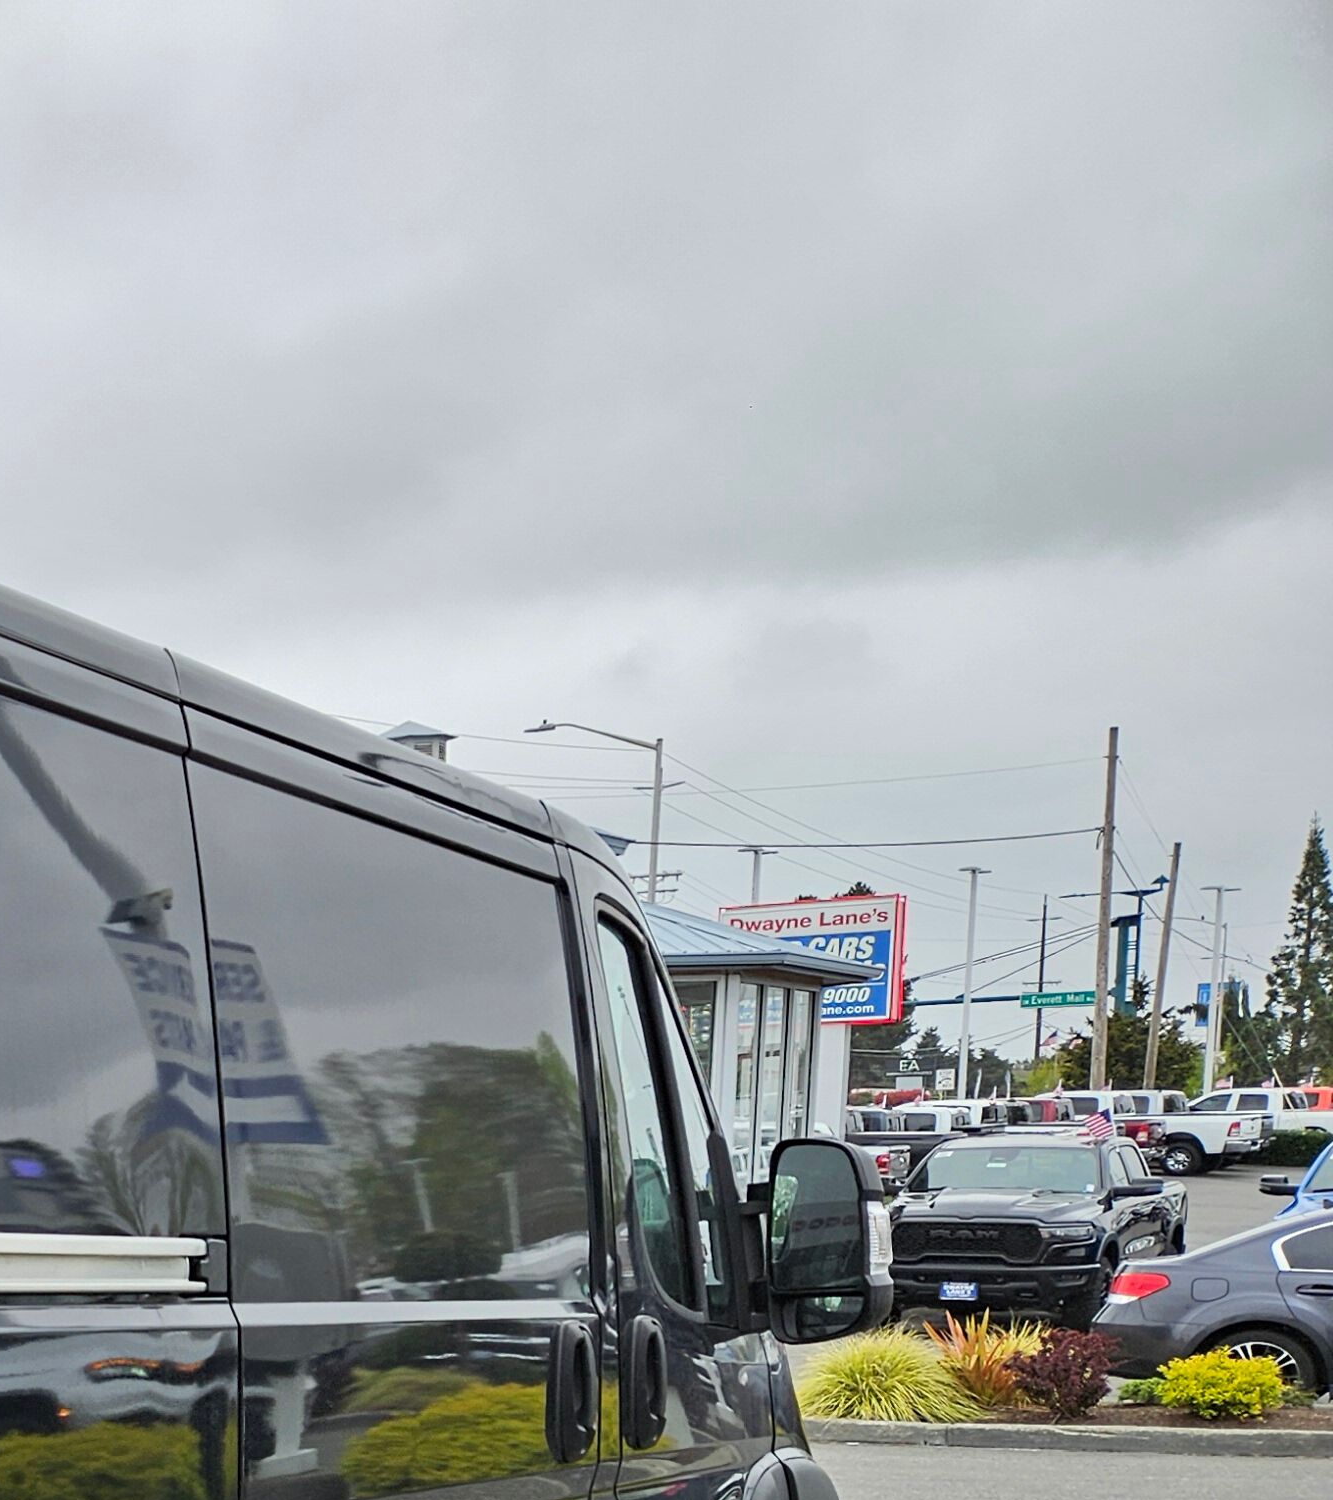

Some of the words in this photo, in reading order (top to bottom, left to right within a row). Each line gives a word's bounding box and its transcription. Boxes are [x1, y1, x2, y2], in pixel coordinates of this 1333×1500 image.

[730, 917, 812, 933] Dwayne
[819, 908, 888, 927] Lane's
[808, 936, 876, 960] CARS
[1031, 995, 1063, 1005] Everett
[1066, 994, 1085, 1003] Mall
[899, 1059, 920, 1071] EA
[929, 1229, 1000, 1239] RAM
